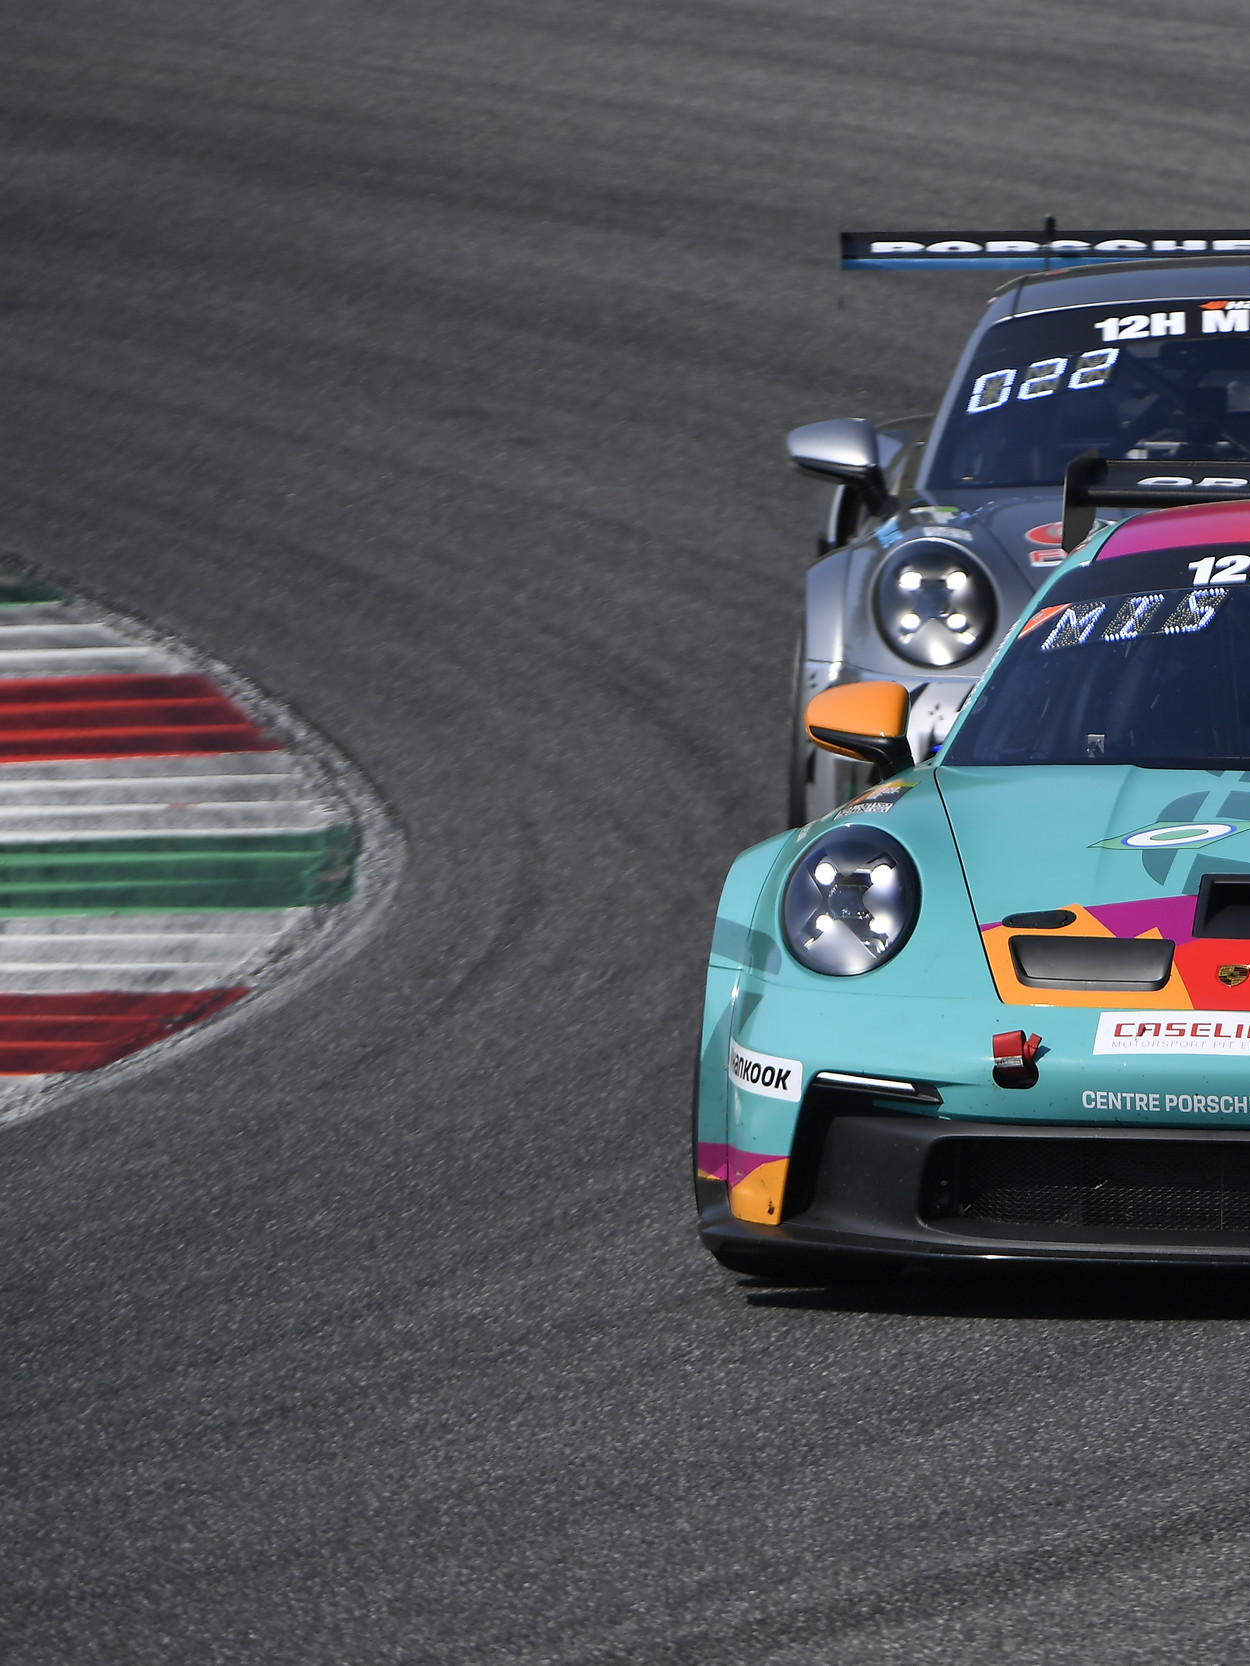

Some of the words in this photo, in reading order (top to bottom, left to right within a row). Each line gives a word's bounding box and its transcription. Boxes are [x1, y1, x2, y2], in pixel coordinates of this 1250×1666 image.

[1095, 310, 1187, 342] 12H
[966, 347, 1120, 415] 022
[1111, 1040, 1206, 1049] MOTORSPORT
[1213, 1041, 1234, 1049] PIT
[1081, 1090, 1161, 1112] CENTRE
